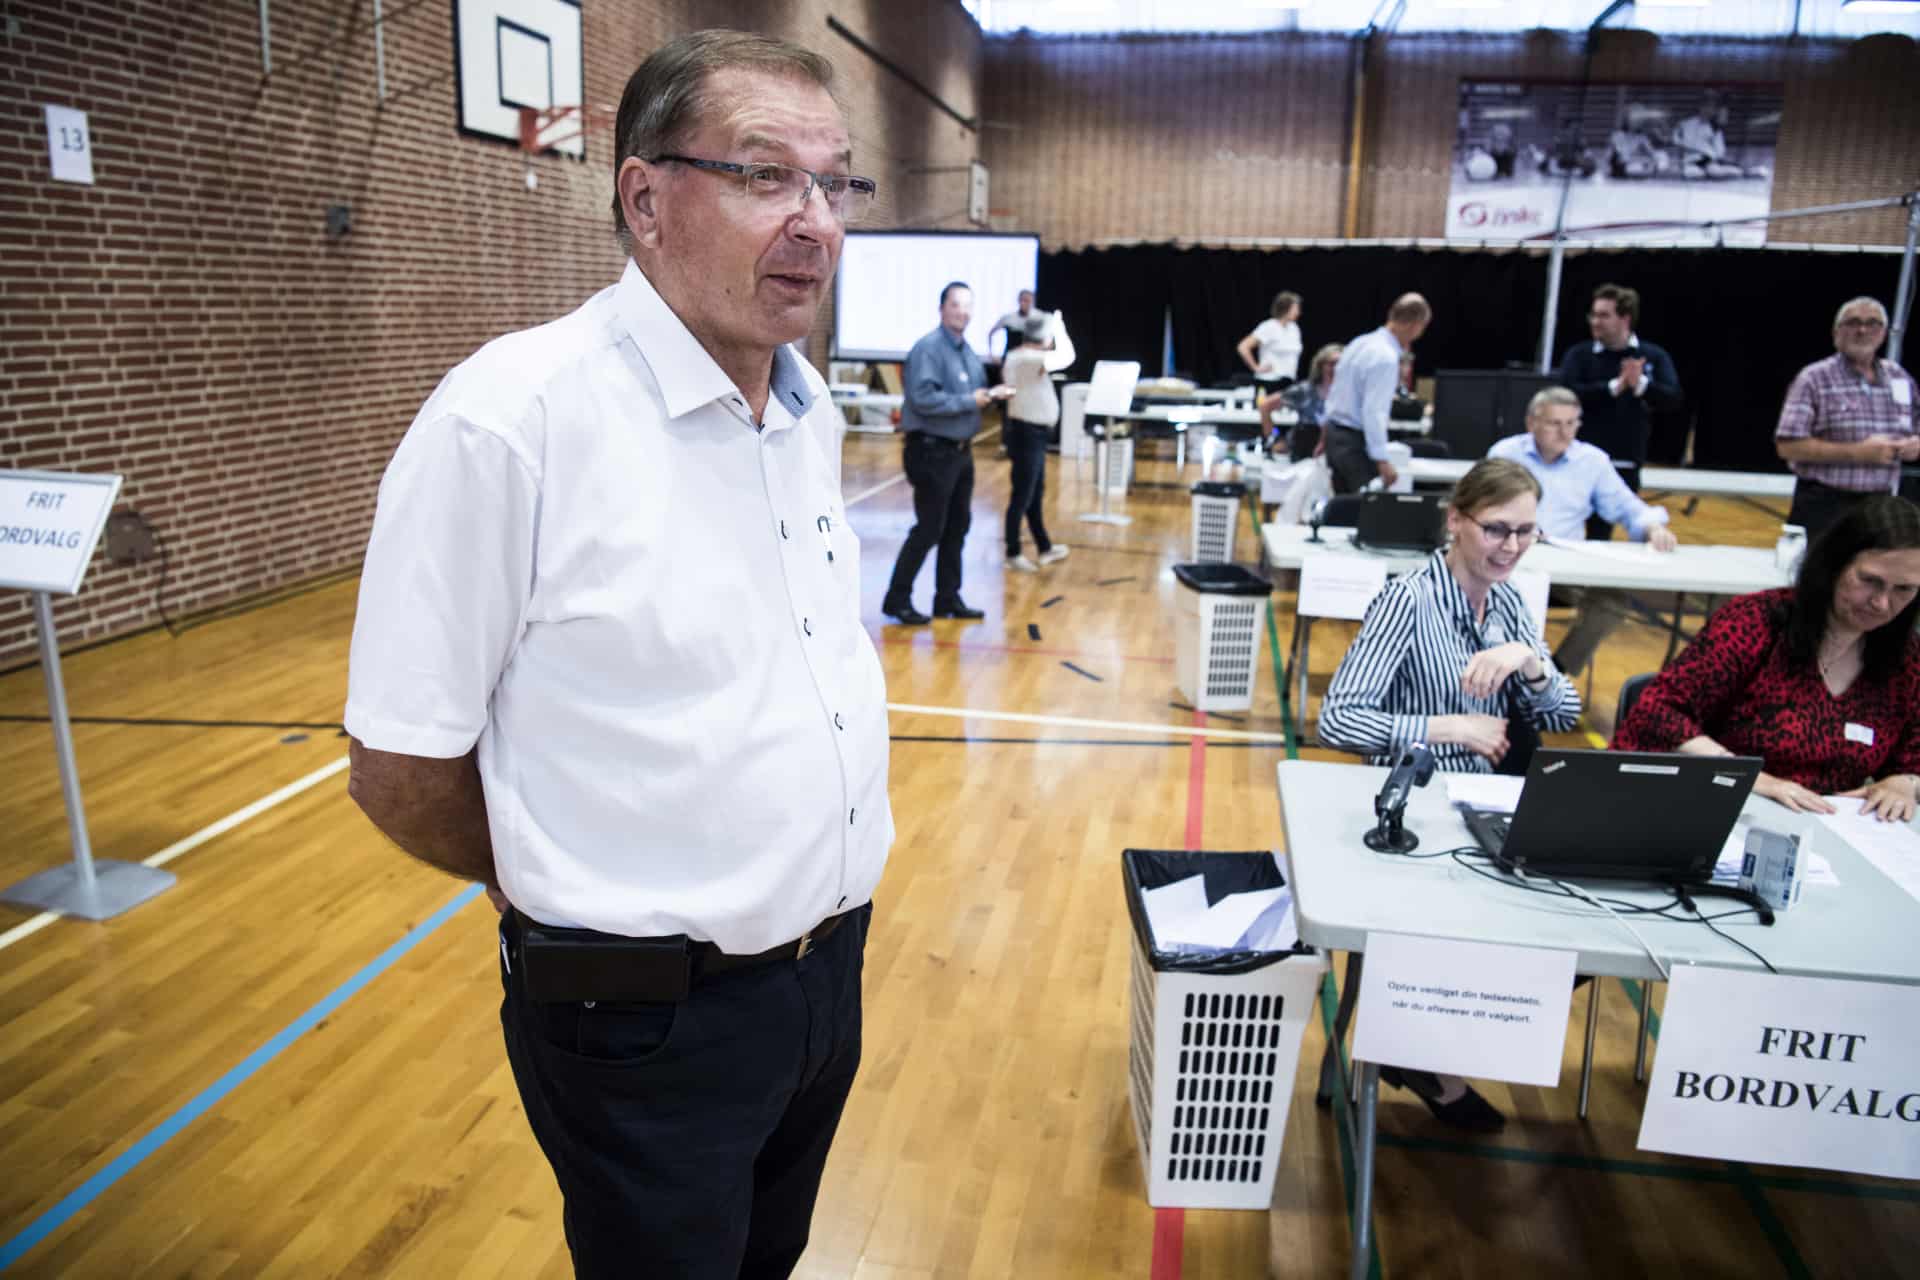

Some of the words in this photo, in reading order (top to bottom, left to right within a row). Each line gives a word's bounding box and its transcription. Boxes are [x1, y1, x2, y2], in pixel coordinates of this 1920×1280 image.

[60, 125, 85, 153] 13
[26, 491, 66, 508] FRIT
[1461, 990, 1478, 999] din
[1411, 1002, 1424, 1011] du
[1473, 1008, 1486, 1017] dit
[1756, 1025, 1867, 1063] FRIT
[1672, 1070, 1920, 1123] BORDVALG
